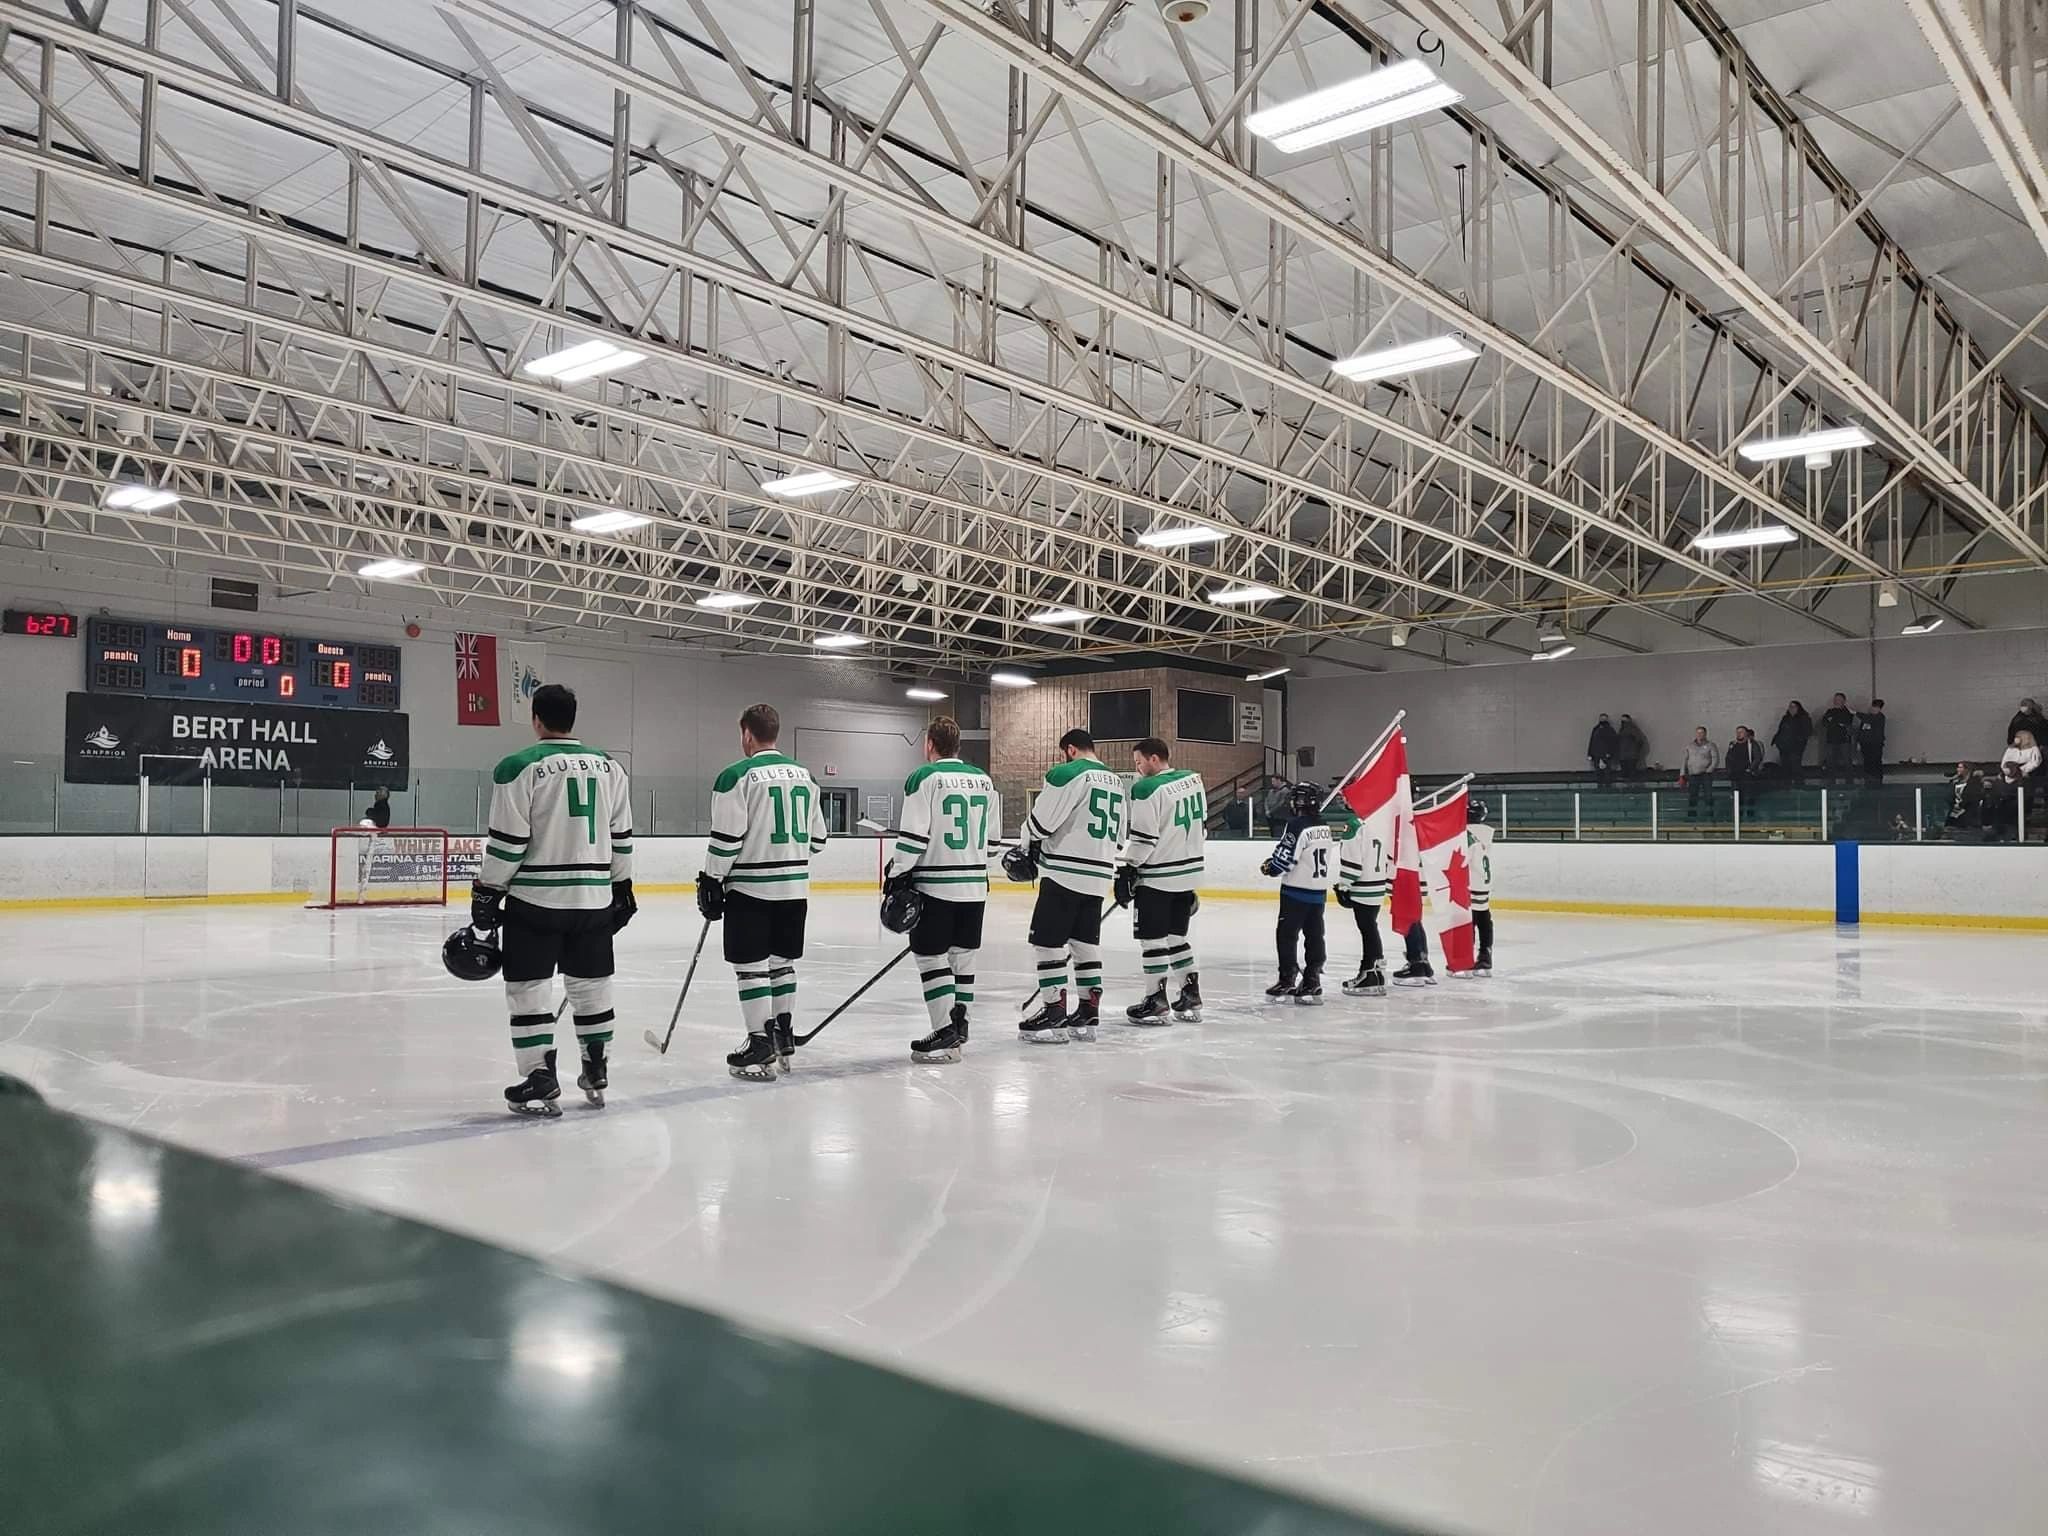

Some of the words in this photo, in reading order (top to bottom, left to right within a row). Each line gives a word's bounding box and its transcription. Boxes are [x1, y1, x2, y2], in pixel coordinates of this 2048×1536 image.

[26, 616, 71, 635] 6:27
[167, 629, 192, 642] Home
[104, 650, 139, 664] penalty
[238, 677, 265, 689] period
[364, 671, 392, 683] penalty
[172, 715, 244, 740] BERT
[251, 718, 318, 744] HALL
[199, 746, 291, 772] ARENA
[536, 759, 610, 779] BLUEBIRD
[566, 777, 596, 844] 4
[768, 785, 810, 844] 10
[943, 794, 988, 850] 37
[1087, 787, 1123, 842] 55
[1175, 791, 1203, 838] 44
[393, 839, 441, 854] WHITE
[1312, 847, 1328, 878] 15
